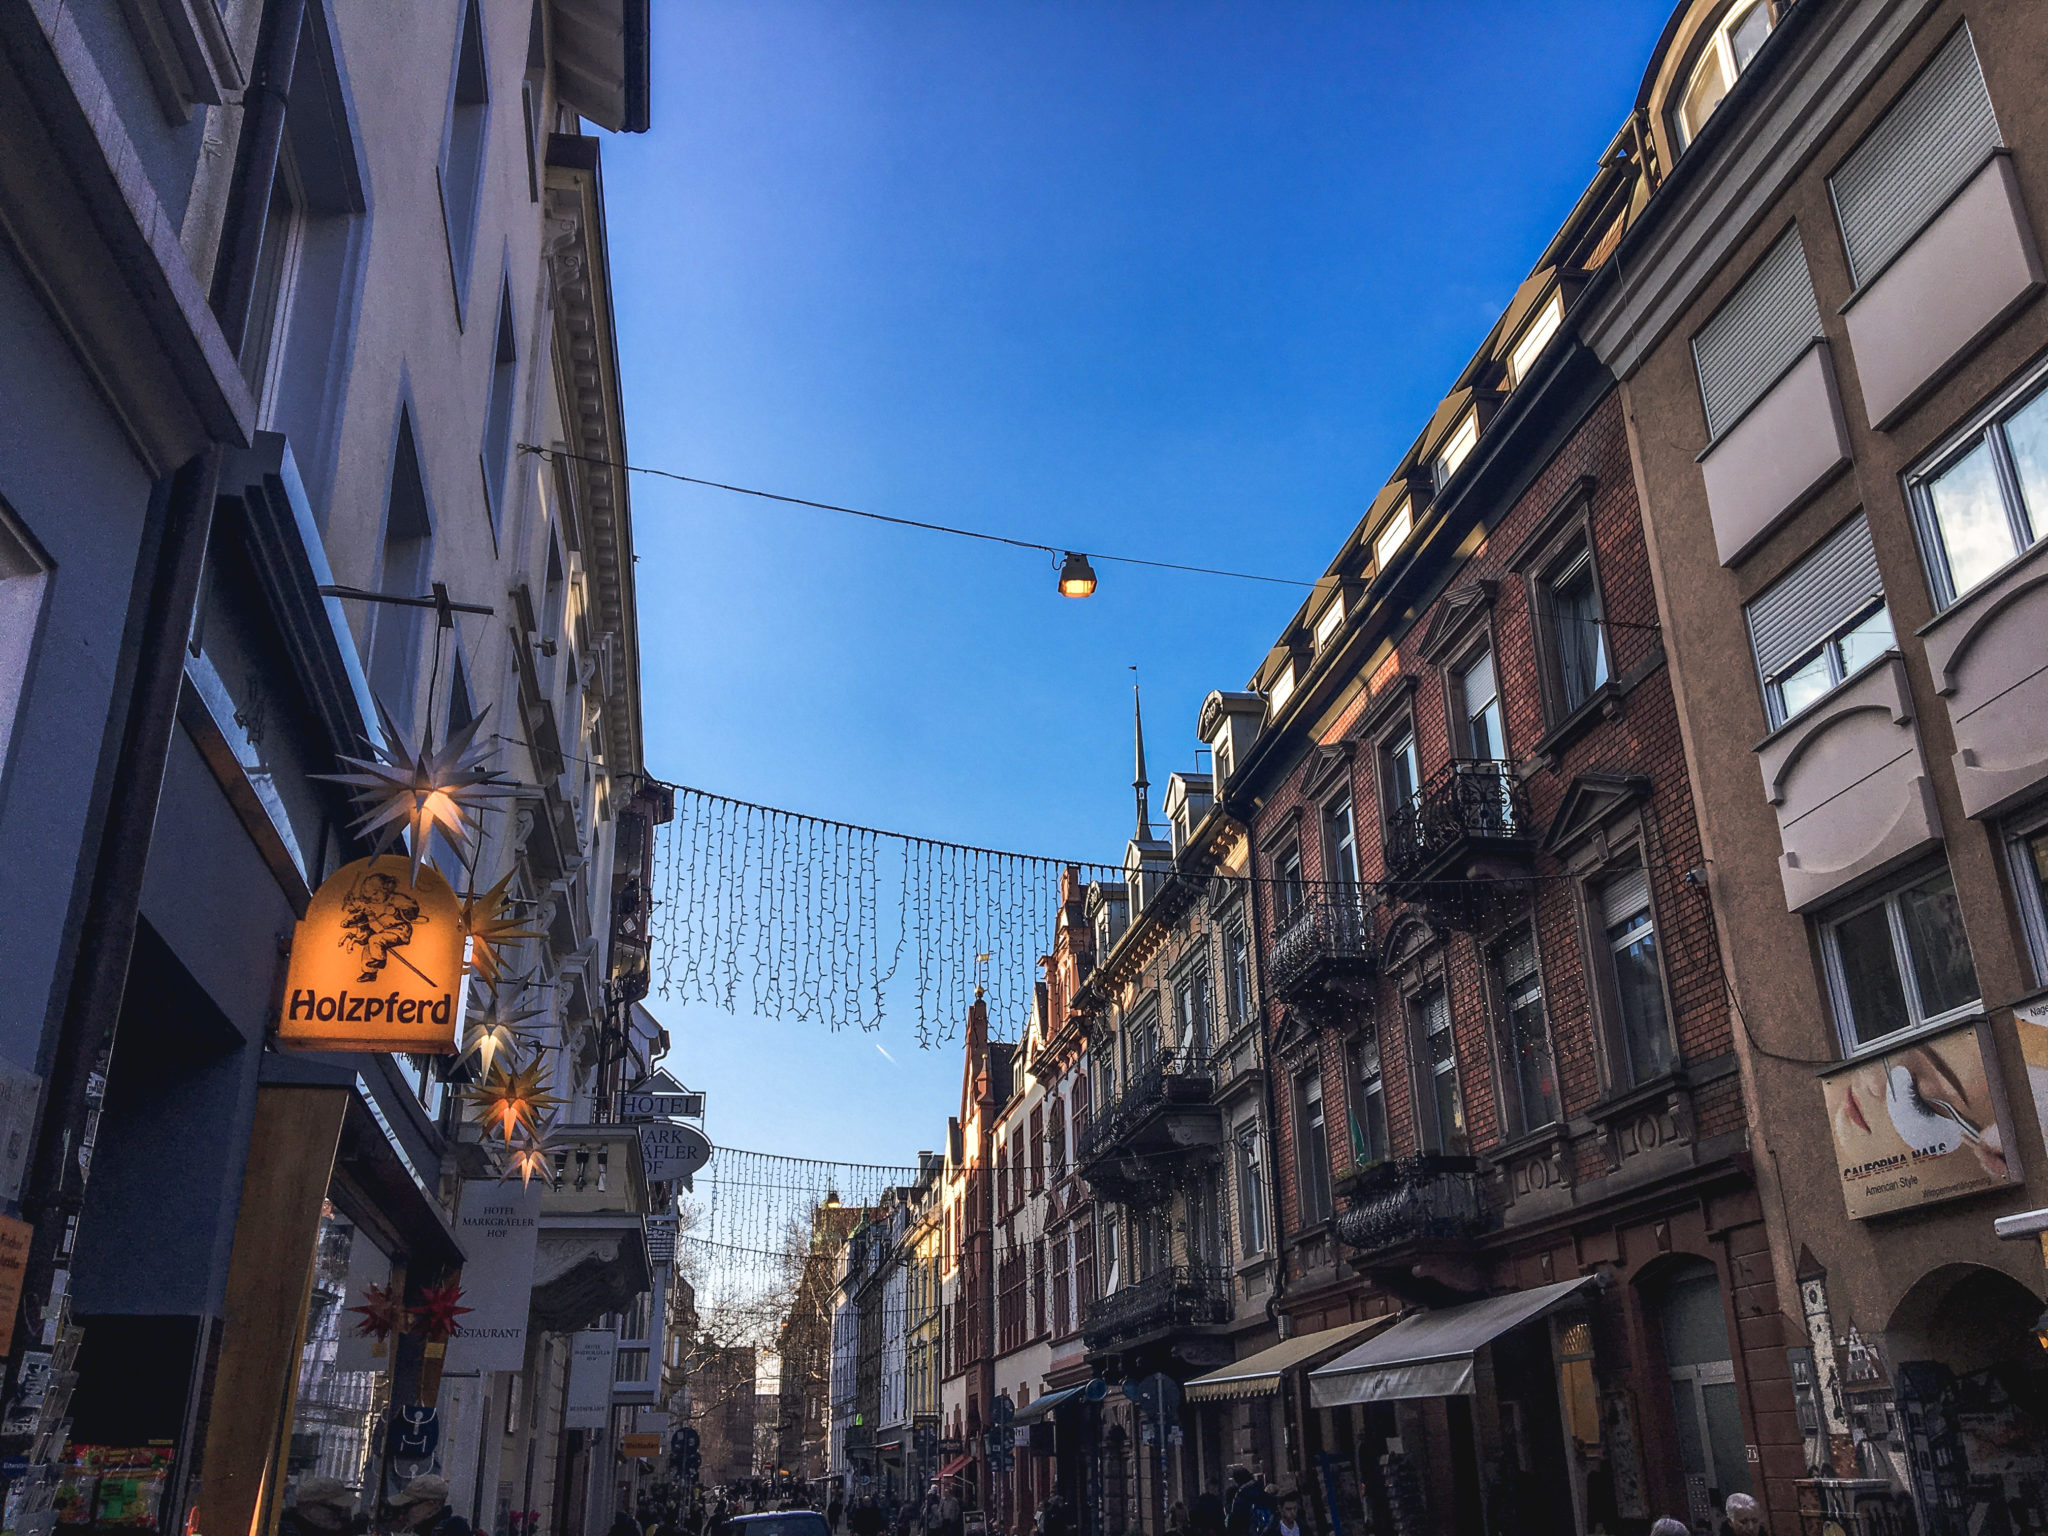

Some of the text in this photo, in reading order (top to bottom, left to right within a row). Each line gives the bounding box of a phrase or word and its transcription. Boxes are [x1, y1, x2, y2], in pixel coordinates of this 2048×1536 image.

[289, 989, 451, 1025] Holzpferd
[623, 1096, 697, 1114] HOTEL
[641, 1130, 683, 1143] ARK
[643, 1144, 697, 1159] ÄFLER
[1865, 1174, 1919, 1197] American Style
[483, 1207, 515, 1215] HOTEL
[487, 1229, 508, 1238] HOF
